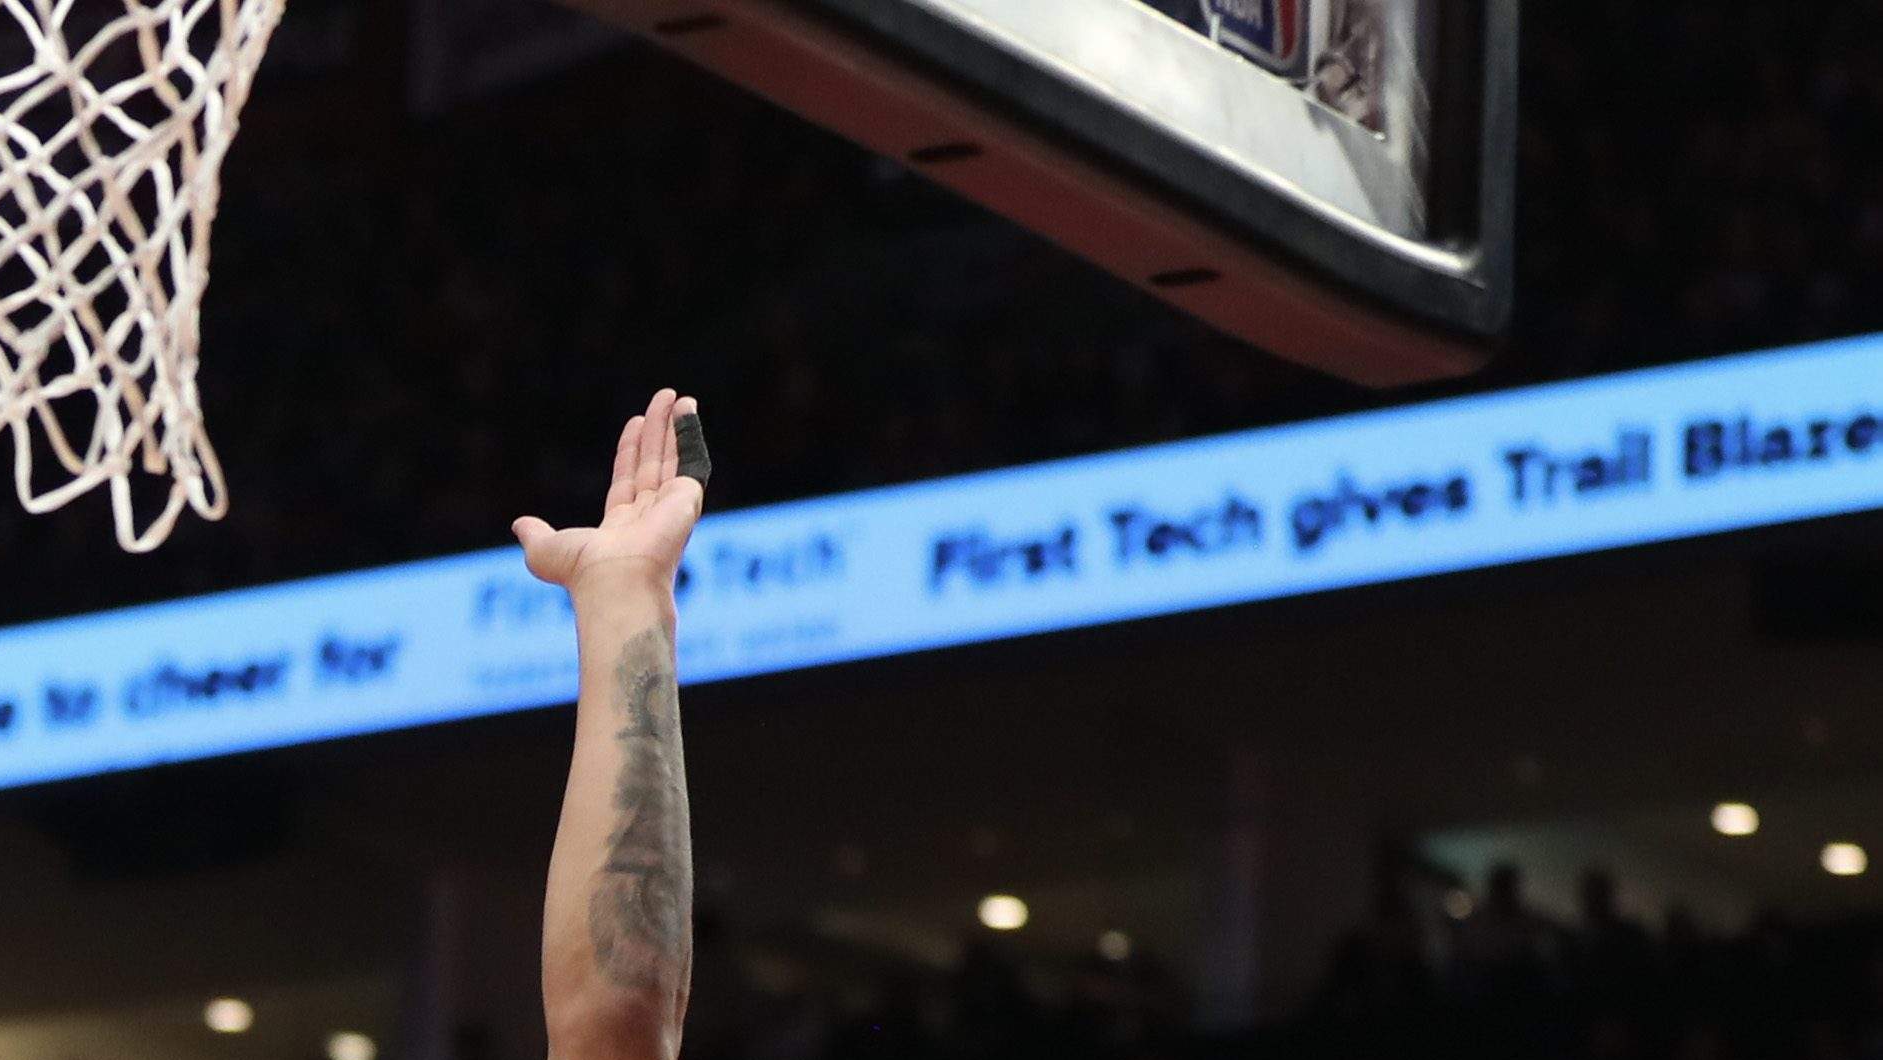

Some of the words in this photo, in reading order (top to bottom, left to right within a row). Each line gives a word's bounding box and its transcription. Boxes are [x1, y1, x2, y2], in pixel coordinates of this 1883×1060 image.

[925, 522, 1078, 598] First
[1103, 488, 1266, 568] Tech
[1286, 468, 1475, 556] gives
[1496, 423, 1655, 508] Trail
[1676, 407, 1883, 483] Blaze
[40, 677, 98, 729] to
[122, 653, 291, 720] cheer
[315, 628, 402, 686] for
